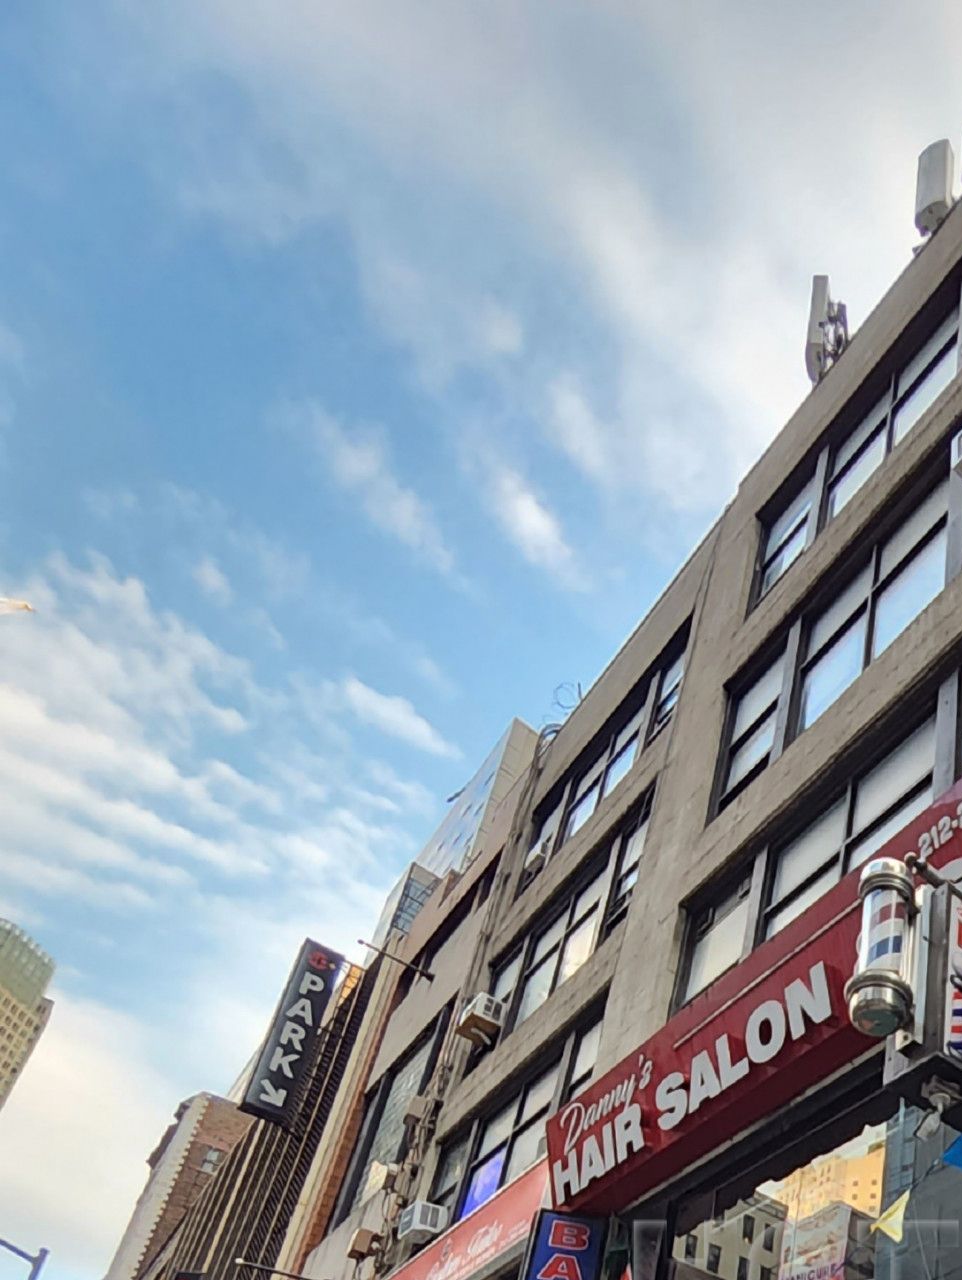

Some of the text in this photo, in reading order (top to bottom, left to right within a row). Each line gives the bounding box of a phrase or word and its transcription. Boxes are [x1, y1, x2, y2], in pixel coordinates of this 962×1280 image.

[269, 971, 325, 1079] PARK
[552, 1102, 645, 1206] HAIR
[655, 962, 832, 1132] SALON
[560, 1054, 652, 1156] Danny's
